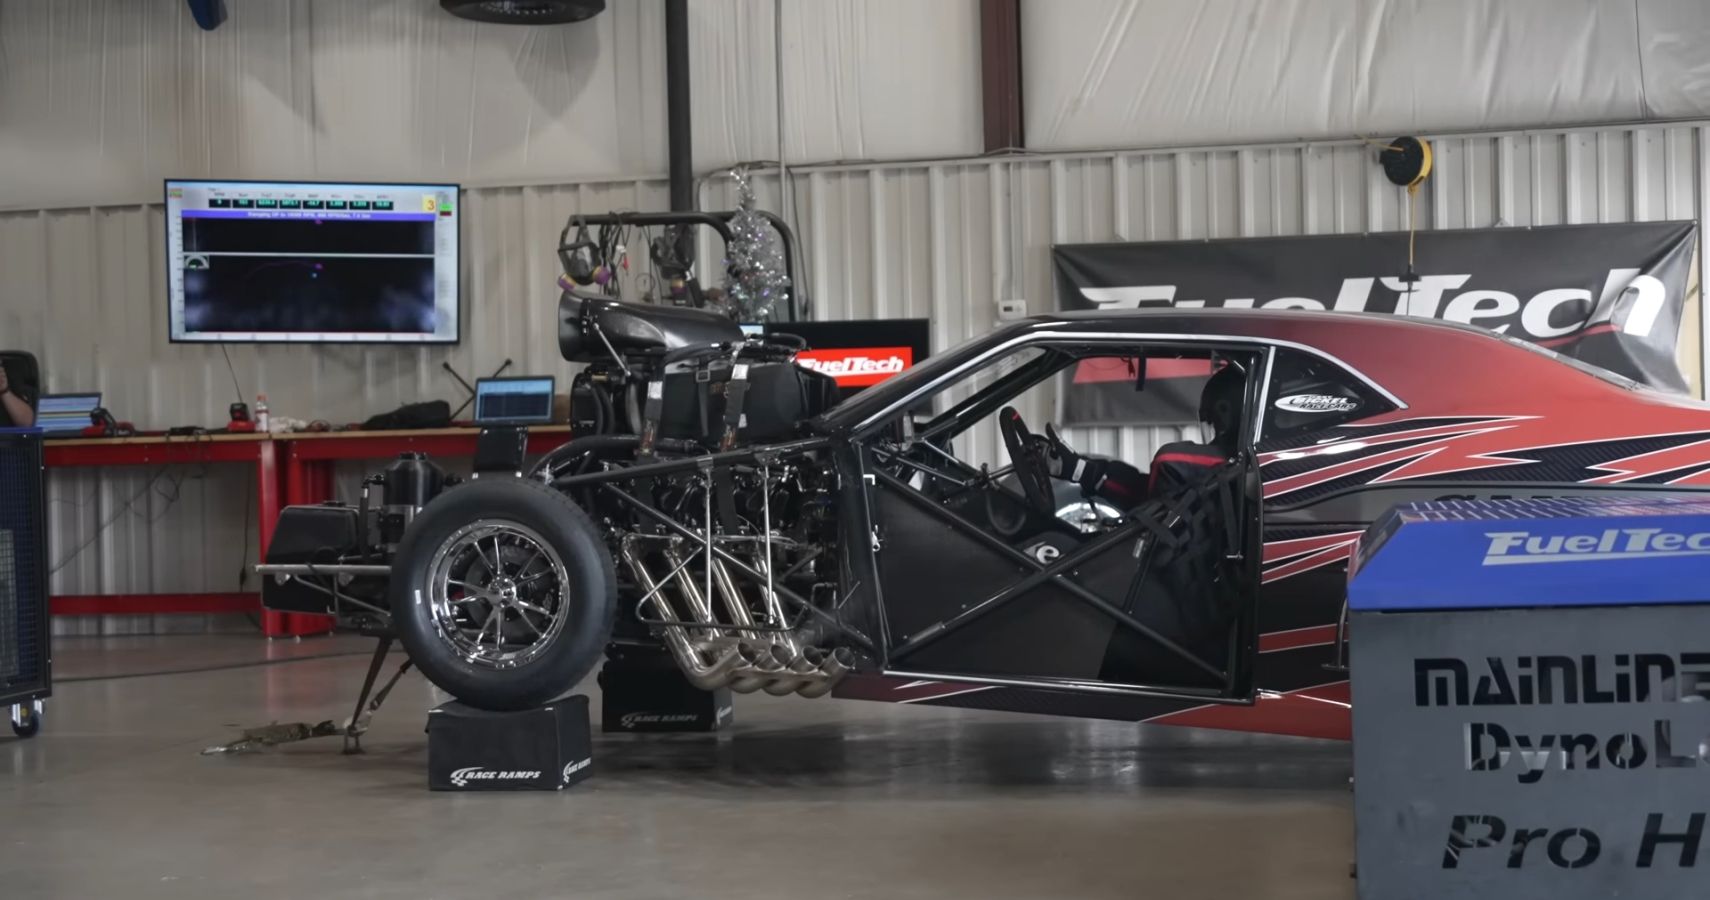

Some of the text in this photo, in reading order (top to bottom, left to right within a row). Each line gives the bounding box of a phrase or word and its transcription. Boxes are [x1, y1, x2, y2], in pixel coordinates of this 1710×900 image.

[427, 199, 435, 211] 3
[1080, 268, 1666, 337] FlTech
[797, 356, 904, 372] FuelTech
[465, 770, 542, 780] RACE RAMPS
[1441, 812, 1707, 870] Pro H
